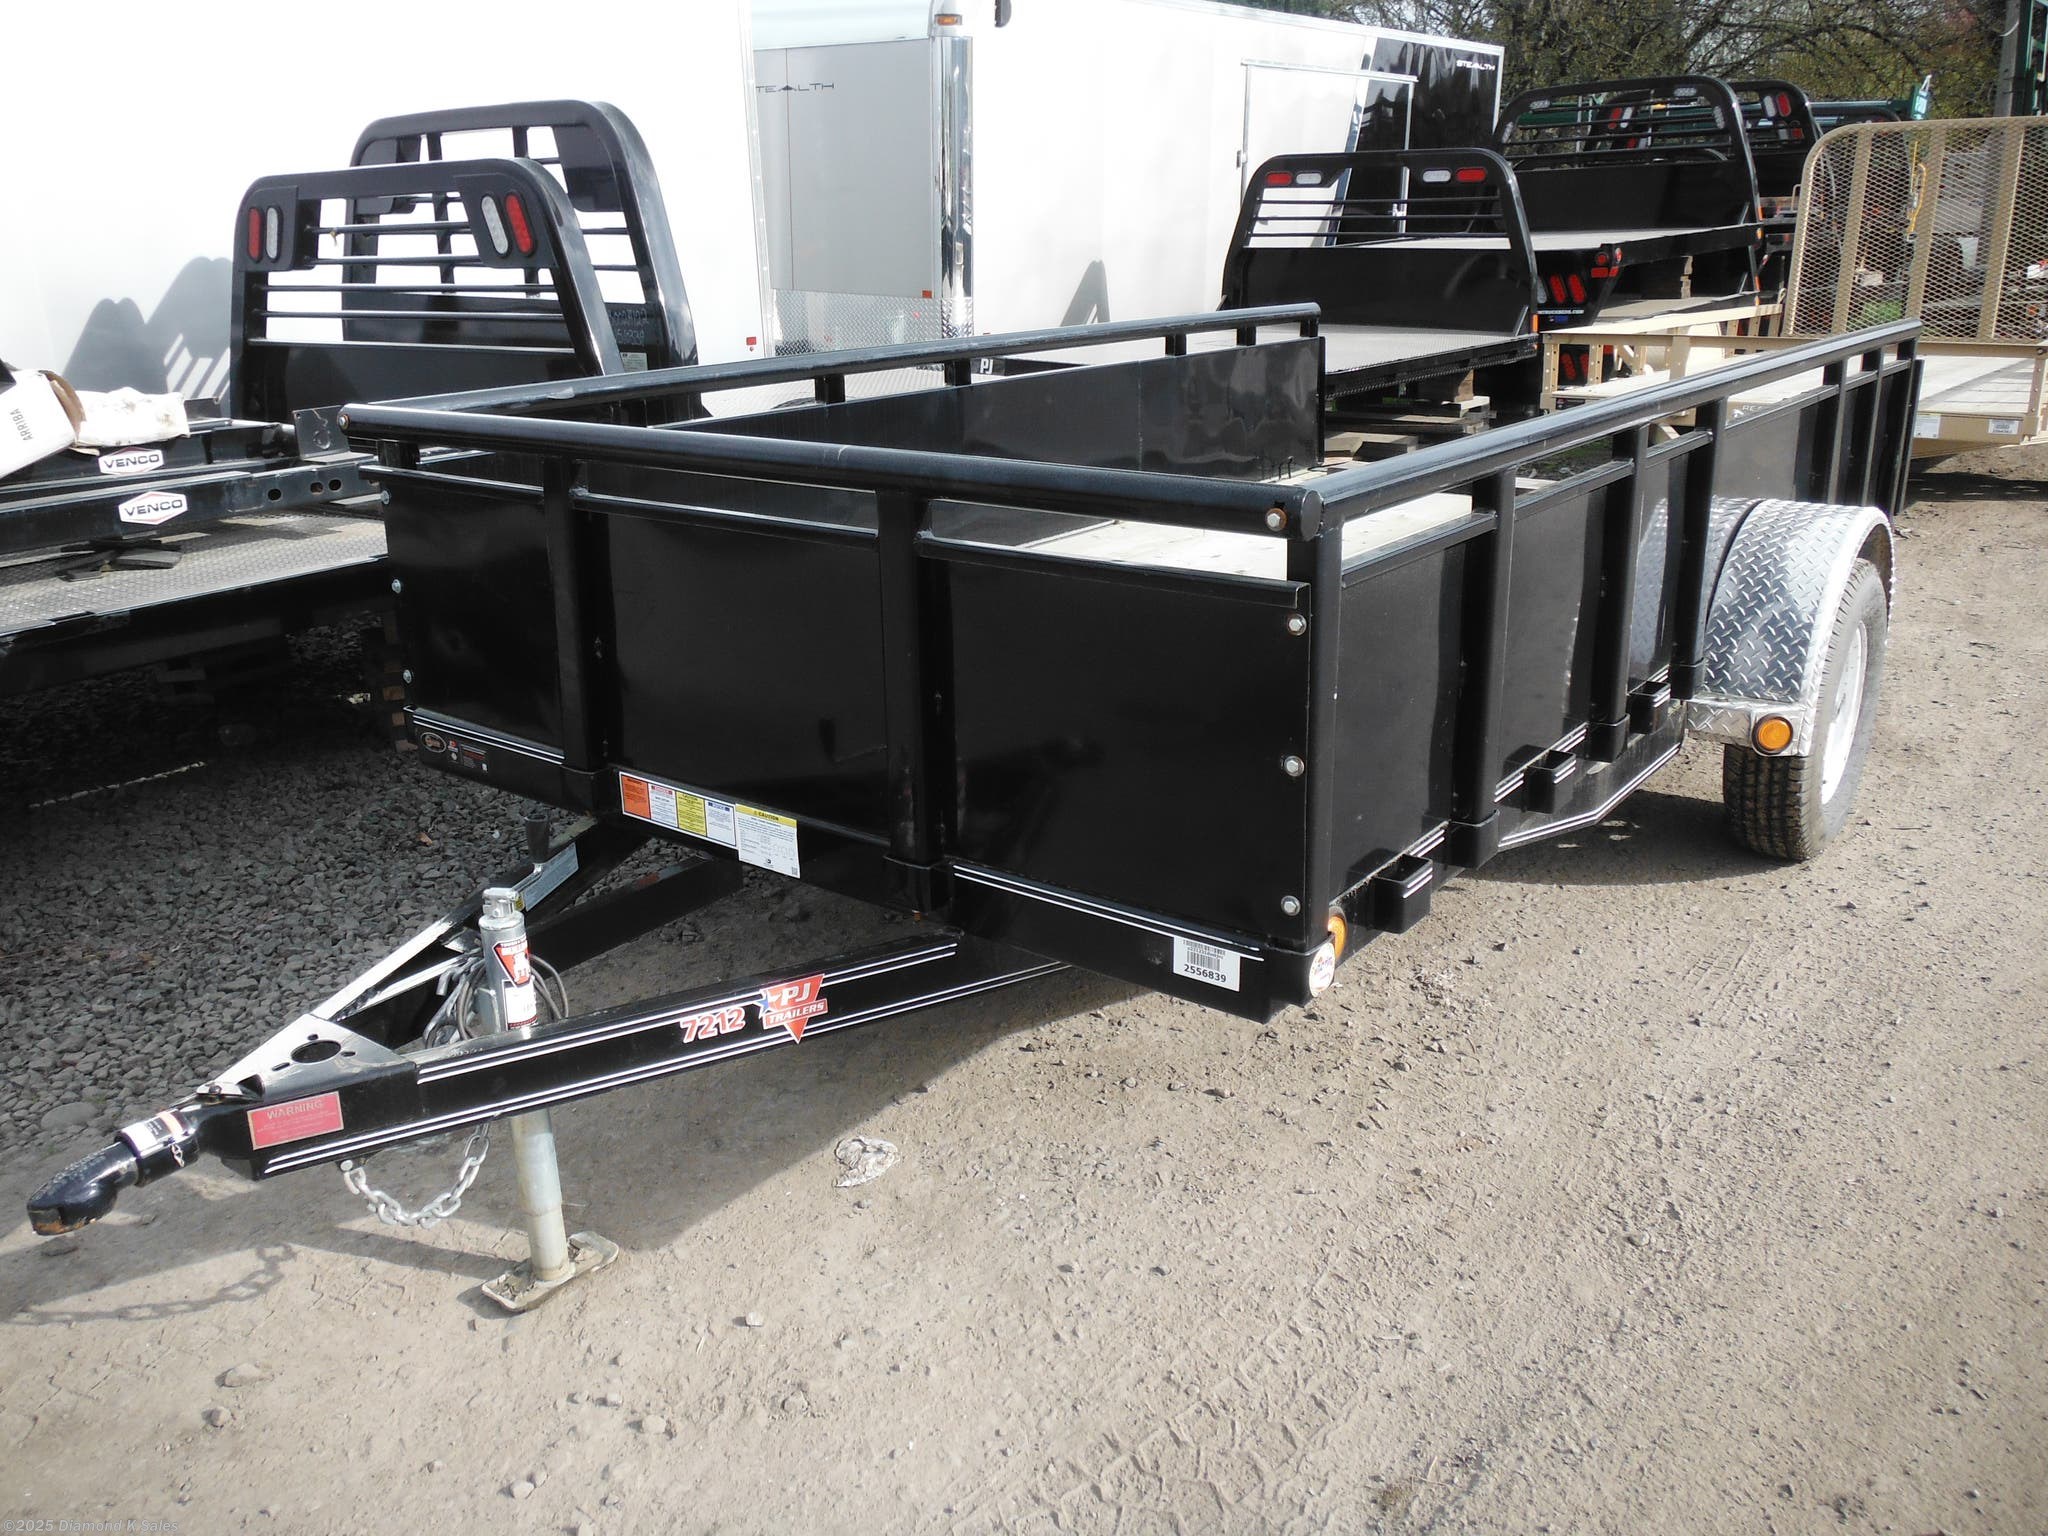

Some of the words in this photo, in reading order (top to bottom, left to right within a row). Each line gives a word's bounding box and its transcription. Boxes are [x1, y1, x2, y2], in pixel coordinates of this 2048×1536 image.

[1456, 60, 1496, 70] STEALTH
[755, 82, 834, 93] TEALTH
[980, 358, 994, 375] PJ
[9, 408, 33, 441] ARRIBA
[104, 454, 160, 469] VENCO
[124, 499, 183, 516] VENCO
[758, 811, 779, 821] CAUTION
[1183, 963, 1227, 983] 2556839
[780, 983, 811, 1006] PJ
[768, 1002, 825, 1024] TRAILERS
[680, 1007, 746, 1044] 7212
[266, 1100, 324, 1120] WARNING
